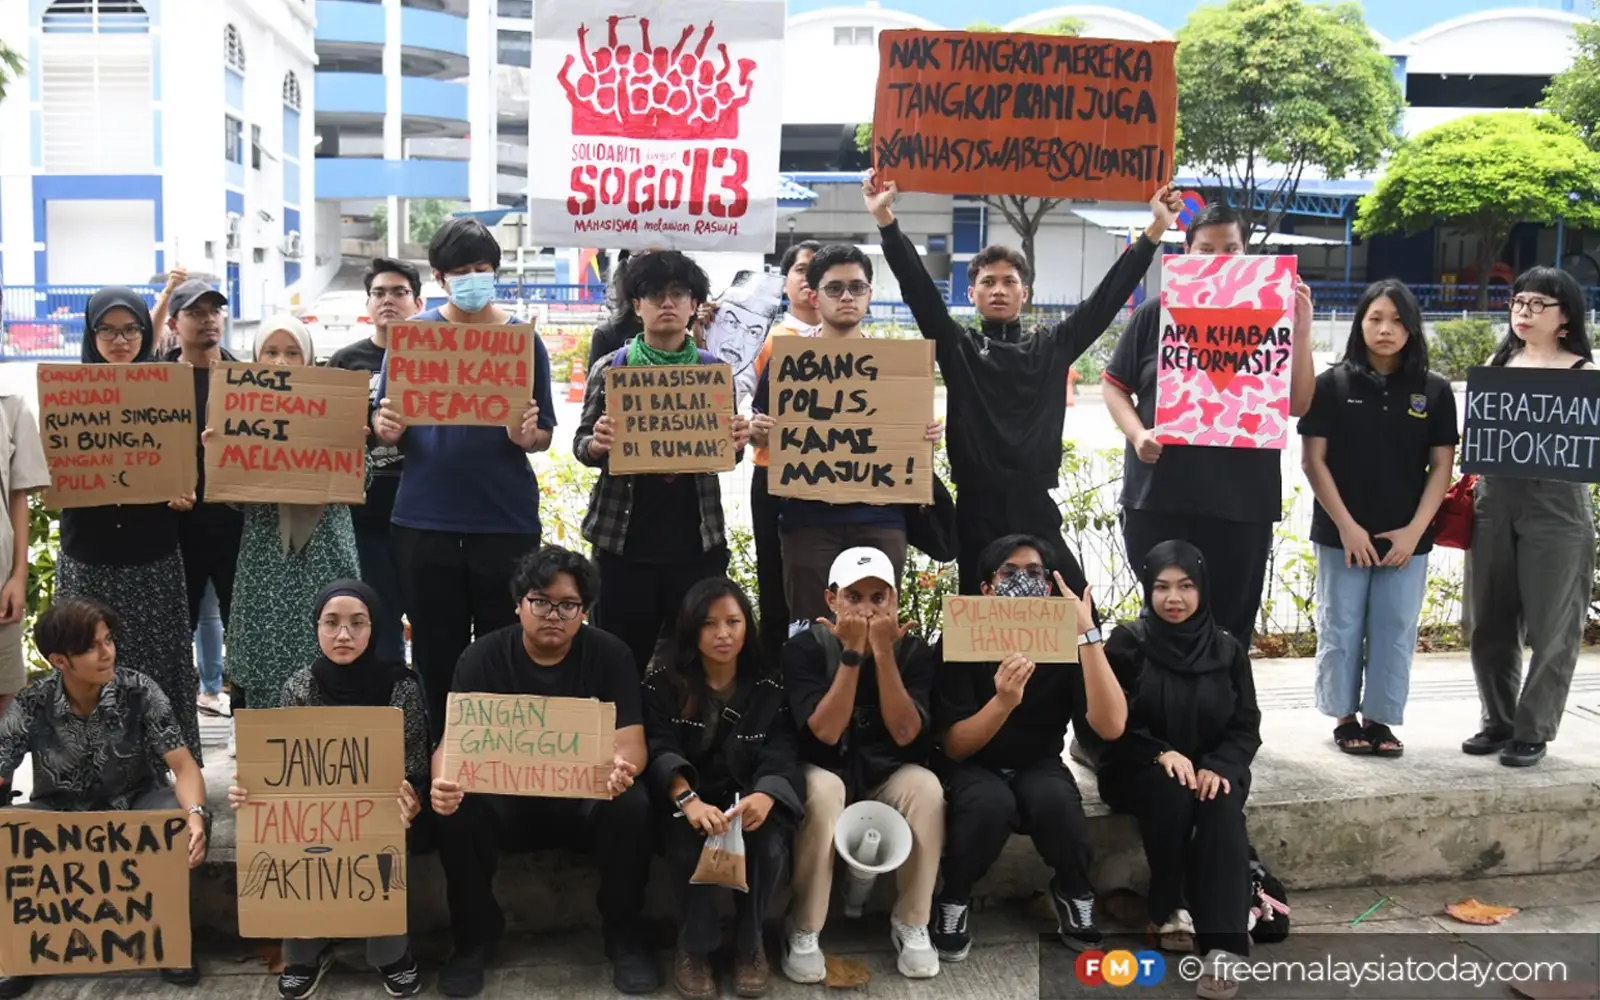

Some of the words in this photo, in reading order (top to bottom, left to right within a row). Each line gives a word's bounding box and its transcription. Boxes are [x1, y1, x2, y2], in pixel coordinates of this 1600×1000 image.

[888, 36, 940, 70] NAK
[944, 38, 1053, 76] TANGKAP
[1053, 42, 1153, 83] MEREKA
[888, 82, 1013, 120] TANGKAP
[1013, 82, 1075, 120] KAMI
[1077, 86, 1157, 125] JUGA
[571, 143, 641, 165] SOLIDARITI
[574, 218, 638, 234] MAHASISWA
[644, 217, 690, 233] melawan
[391, 325, 458, 352] PMX
[463, 328, 526, 357] DULU
[1161, 323, 1199, 343] APA
[1206, 324, 1292, 346] KHABAR
[39, 366, 117, 384] CUKUPLAH
[125, 367, 170, 382] KAMI
[389, 356, 450, 386] PUN
[457, 358, 527, 388] KAKI
[777, 349, 878, 384] ABANG
[1161, 345, 1290, 377] REFORMASI?
[225, 367, 293, 393] LAGI
[612, 370, 725, 389] MAHASISWA
[43, 387, 121, 409] MENJADI
[224, 392, 327, 418] DITEKAN
[402, 389, 511, 423] DEMO
[622, 393, 642, 412] DI
[778, 388, 878, 420] POLIS,
[1467, 390, 1600, 426] KERAJAAN
[45, 410, 111, 431] RUMAH
[121, 408, 192, 426] SINGGAH
[223, 418, 290, 442] LAGI
[626, 412, 719, 433] PERASUAH
[49, 434, 68, 450] SI
[77, 431, 162, 451] BUNGA,
[622, 441, 640, 457] DI
[650, 438, 728, 458] RUMAH?
[781, 426, 878, 455] KAMI
[1464, 427, 1600, 469] HIPOKRIT
[124, 451, 161, 467] IPD
[218, 444, 364, 479] MELAWAN!
[56, 472, 107, 493] PULA
[948, 598, 1066, 628] PULANGKAN
[970, 624, 1061, 653] HAMDIN
[449, 697, 549, 728] JANGAN
[459, 728, 581, 757] GANGGU
[264, 736, 370, 788] JANGAN
[456, 758, 613, 795] AKTIVINISME
[248, 799, 375, 845] TANGKAP
[0, 817, 188, 858] TANGKAP
[5, 858, 142, 901] FARIS
[260, 851, 394, 902] AKTIVIS!
[12, 891, 154, 926] BUKAN
[29, 924, 165, 965] KAMI
